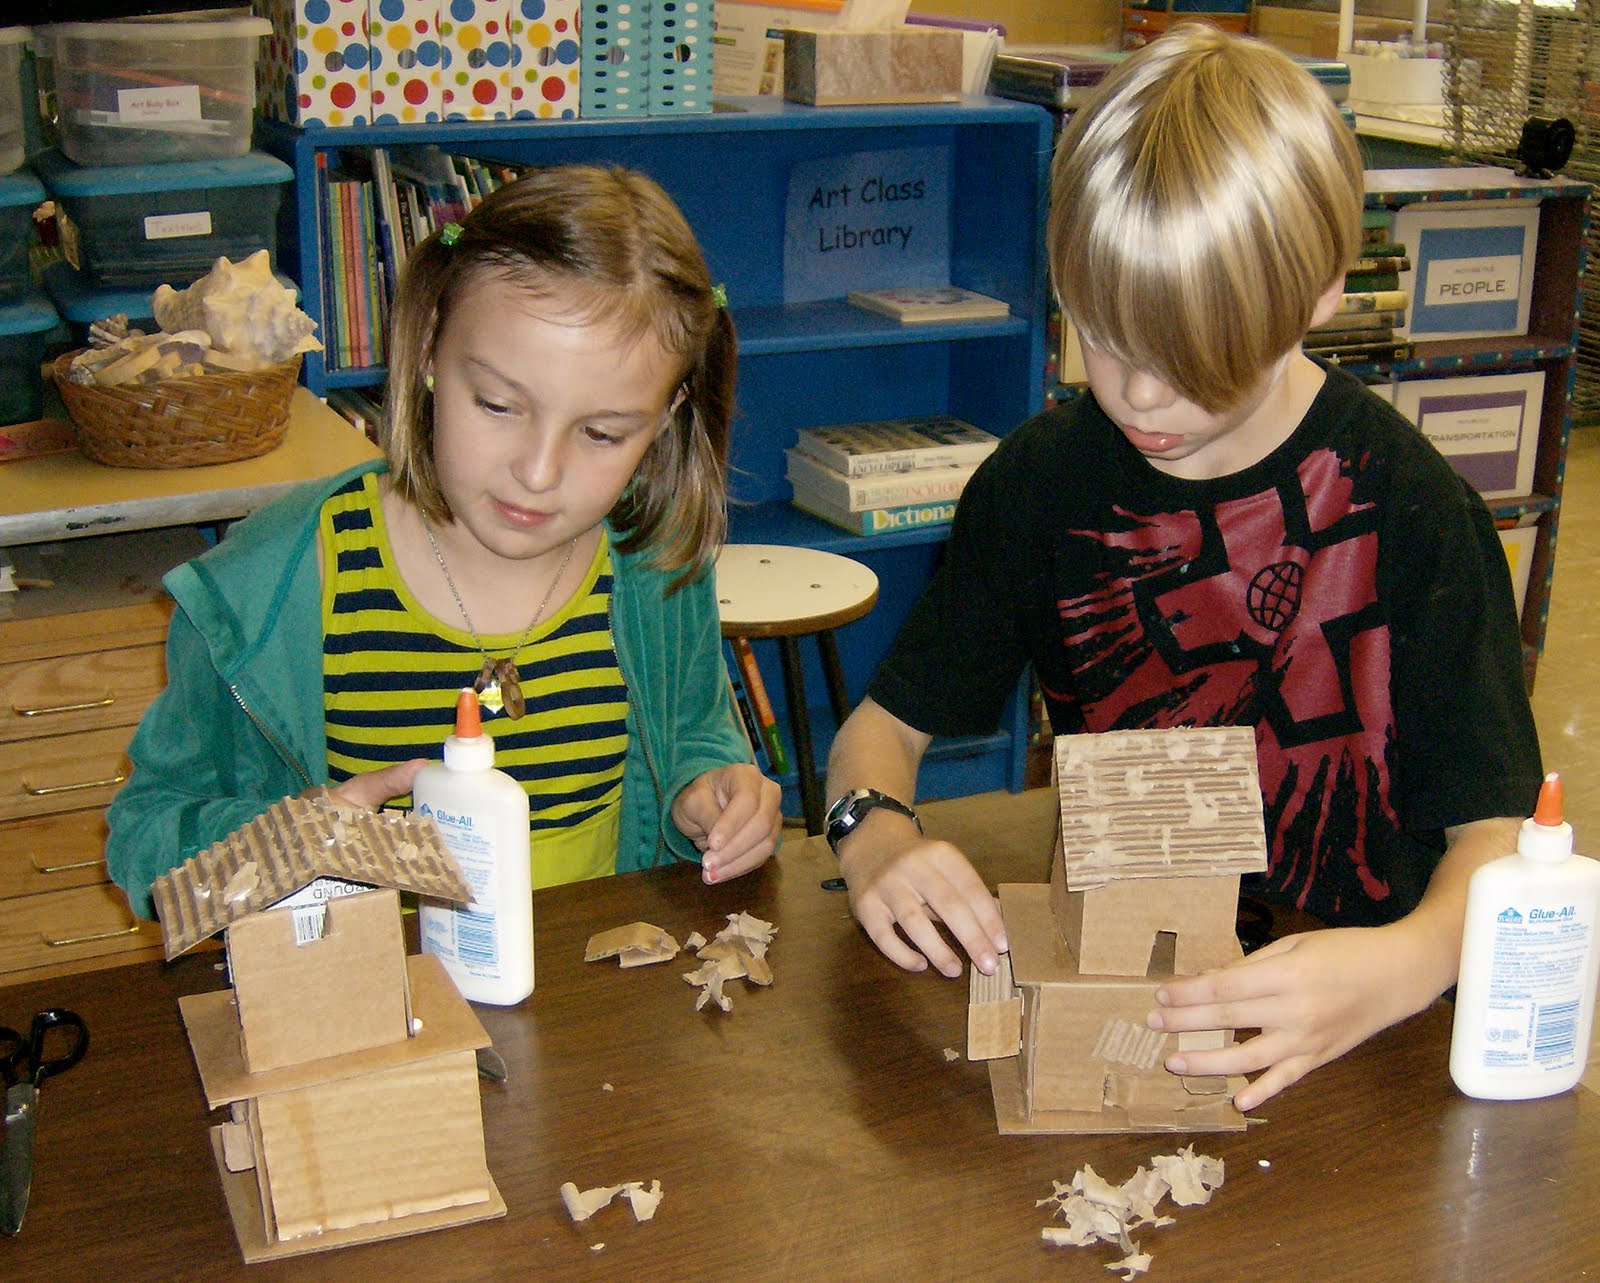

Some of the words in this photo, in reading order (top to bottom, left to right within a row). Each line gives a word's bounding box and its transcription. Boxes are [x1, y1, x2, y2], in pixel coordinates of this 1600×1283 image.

[808, 185, 851, 208] Art
[861, 176, 925, 203] Class
[819, 224, 912, 251] Library
[1439, 279, 1506, 296] PEOPLE
